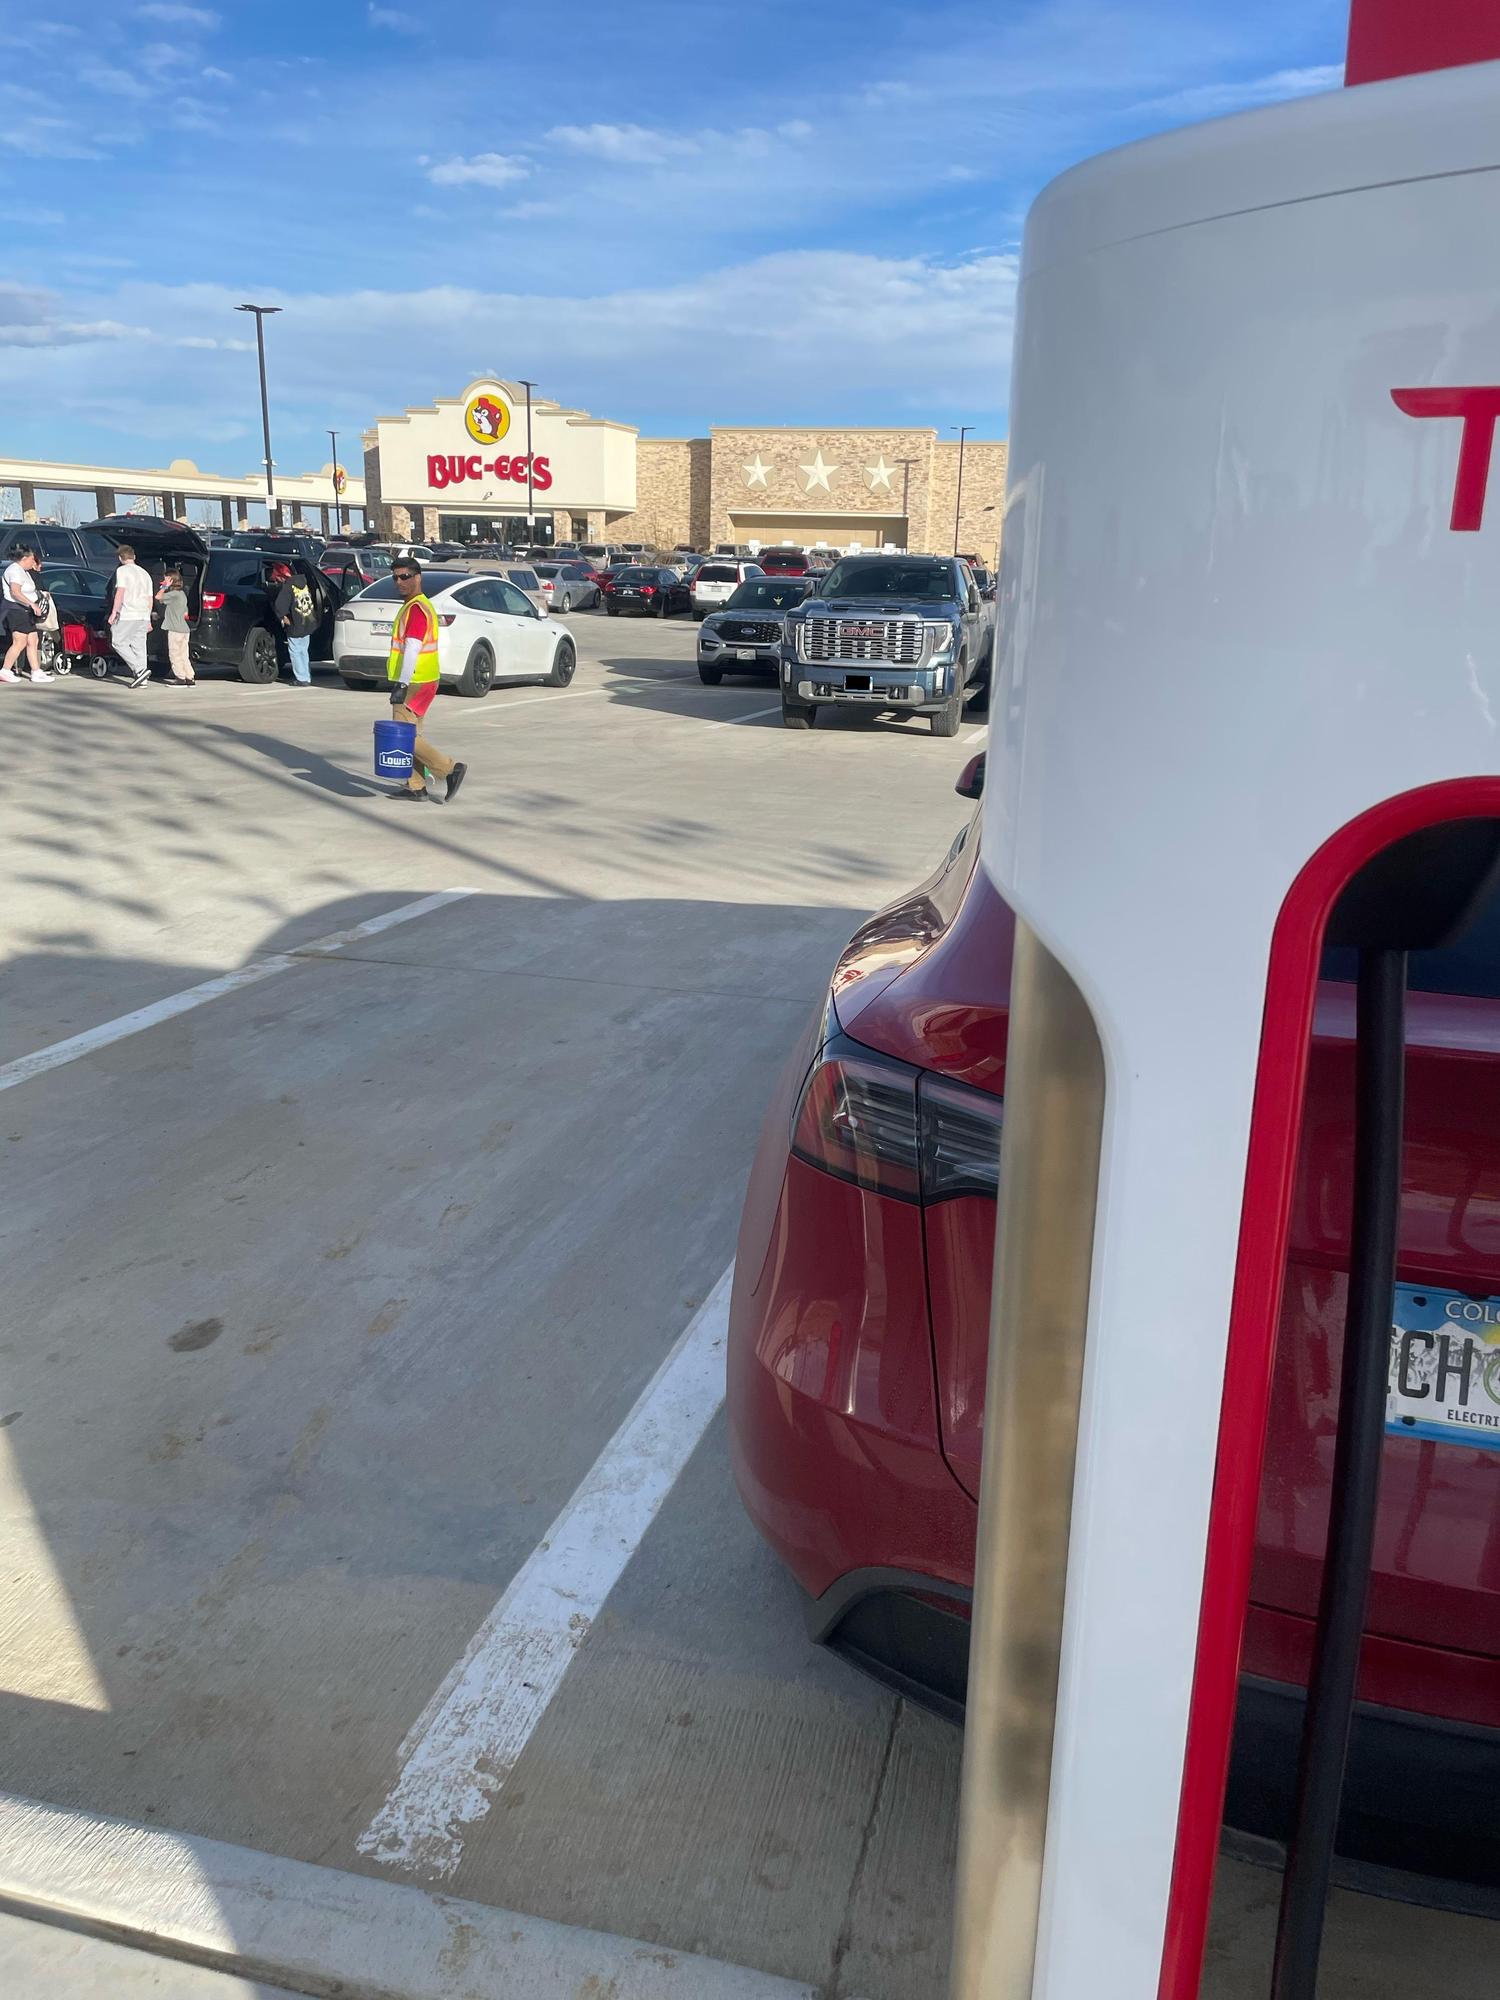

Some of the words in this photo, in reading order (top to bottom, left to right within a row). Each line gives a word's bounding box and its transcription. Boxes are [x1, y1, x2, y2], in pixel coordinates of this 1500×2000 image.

[840, 626, 885, 637] GMC
[382, 755, 411, 766] LOWE'S
[1445, 1300, 1500, 1324] COL
[1386, 1327, 1473, 1406] CH
